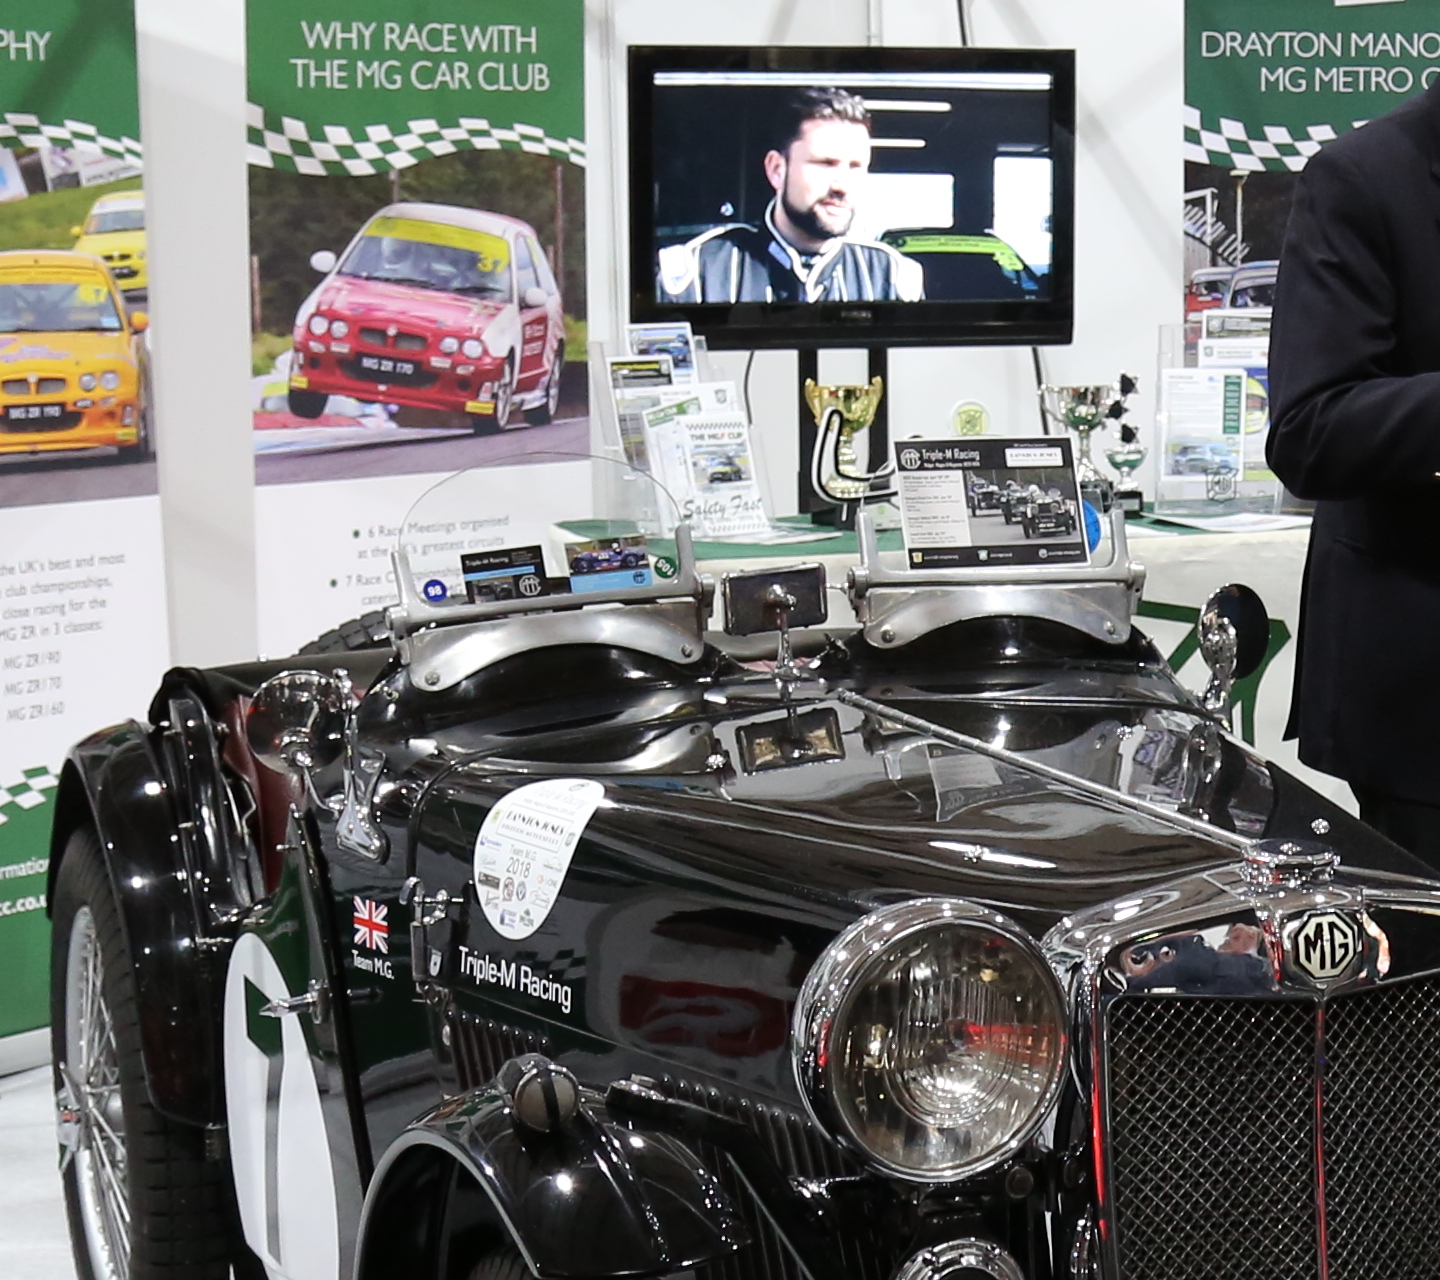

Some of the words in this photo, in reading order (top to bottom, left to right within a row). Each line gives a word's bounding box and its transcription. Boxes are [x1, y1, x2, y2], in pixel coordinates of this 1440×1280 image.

[301, 21, 379, 51] WHY
[384, 22, 459, 53] RACE
[461, 24, 538, 54] WITH
[1201, 31, 1342, 58] DRAYTON
[290, 58, 349, 89] THE
[355, 60, 403, 90] MG
[409, 61, 473, 92] CAR
[476, 62, 550, 93] CLUB
[1260, 66, 1306, 93] MG
[1315, 67, 1413, 93] METRO
[683, 499, 725, 519] Safety
[729, 495, 762, 515] Fast
[427, 585, 443, 597] 98
[506, 856, 532, 879] 2018
[351, 949, 373, 972] Team
[1302, 920, 1357, 978] MG
[459, 945, 516, 990] Triple-M
[520, 966, 572, 1014] Racing
